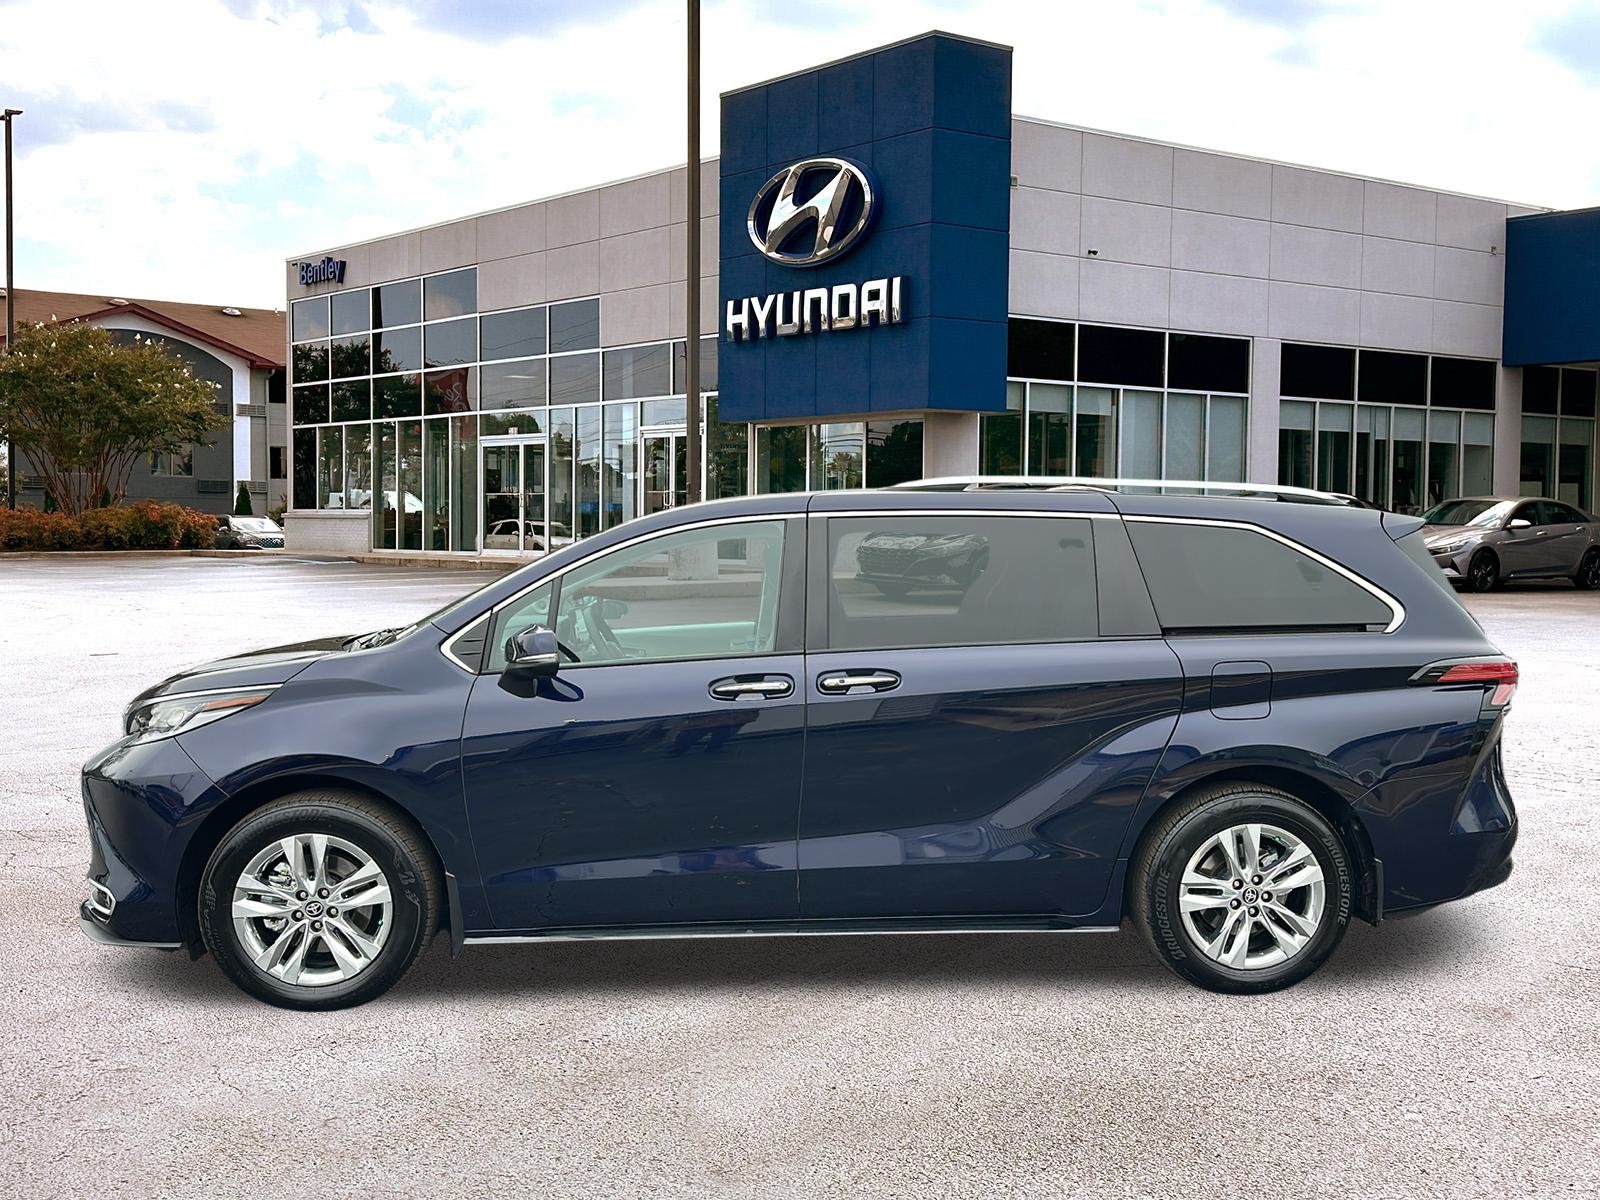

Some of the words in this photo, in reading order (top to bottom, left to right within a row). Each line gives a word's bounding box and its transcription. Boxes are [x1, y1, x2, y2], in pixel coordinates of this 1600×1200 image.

[299, 256, 345, 282] Bentley
[726, 276, 903, 341] HYUNDAI
[1155, 869, 1187, 961] BRIDGESTONE
[1324, 836, 1352, 926] BRIDGESTONE
